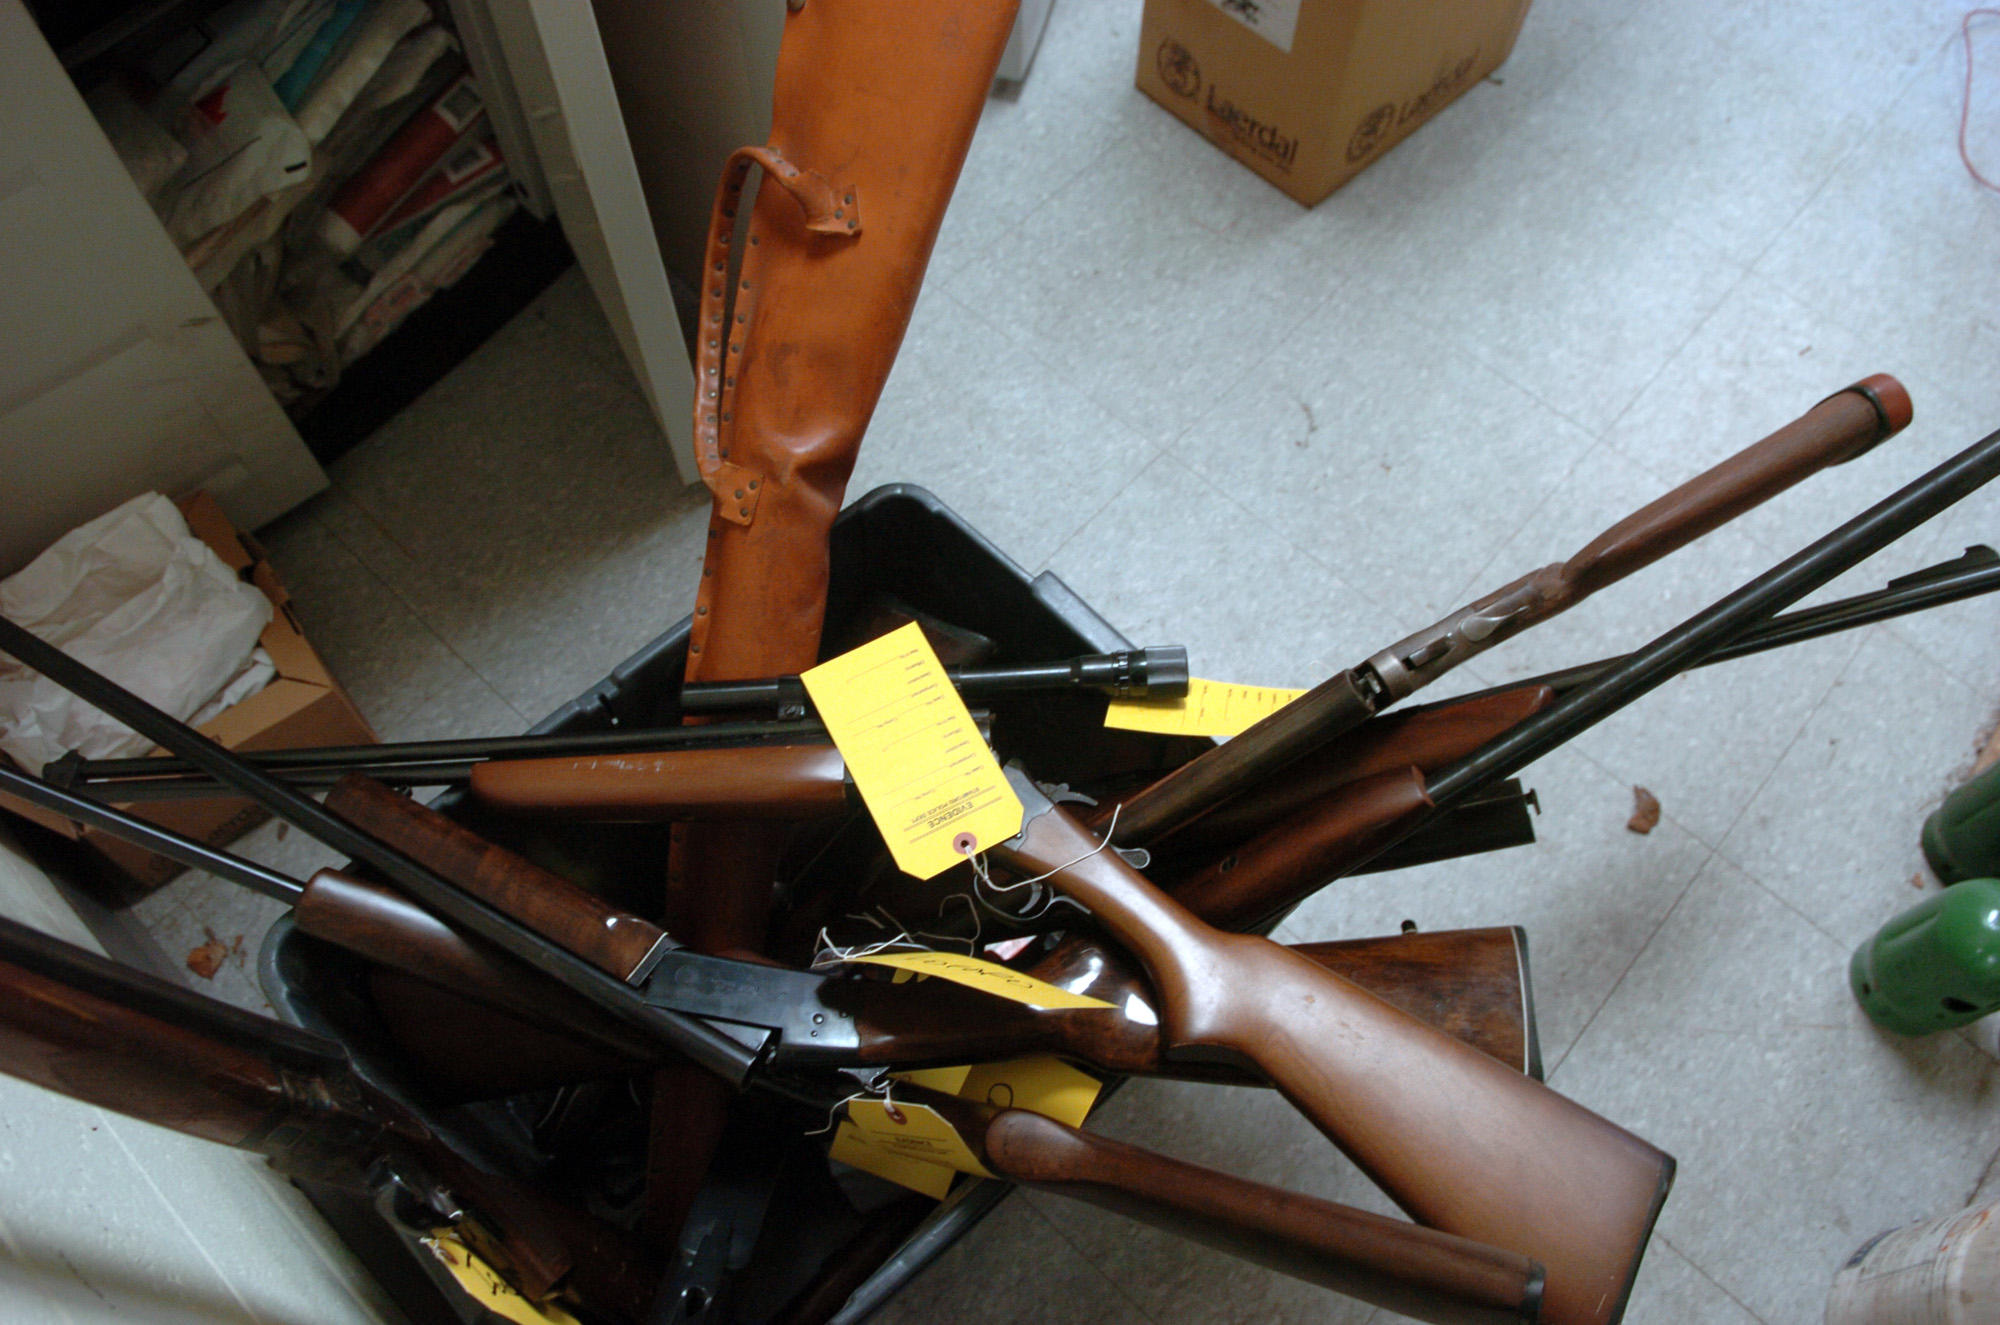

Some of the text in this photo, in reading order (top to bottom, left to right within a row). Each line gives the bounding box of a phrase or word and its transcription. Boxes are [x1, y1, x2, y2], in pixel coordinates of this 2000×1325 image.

[1207, 84, 1298, 163] Laerdal
[926, 801, 948, 815] POLICE
[926, 801, 974, 828] EVIDENCE
